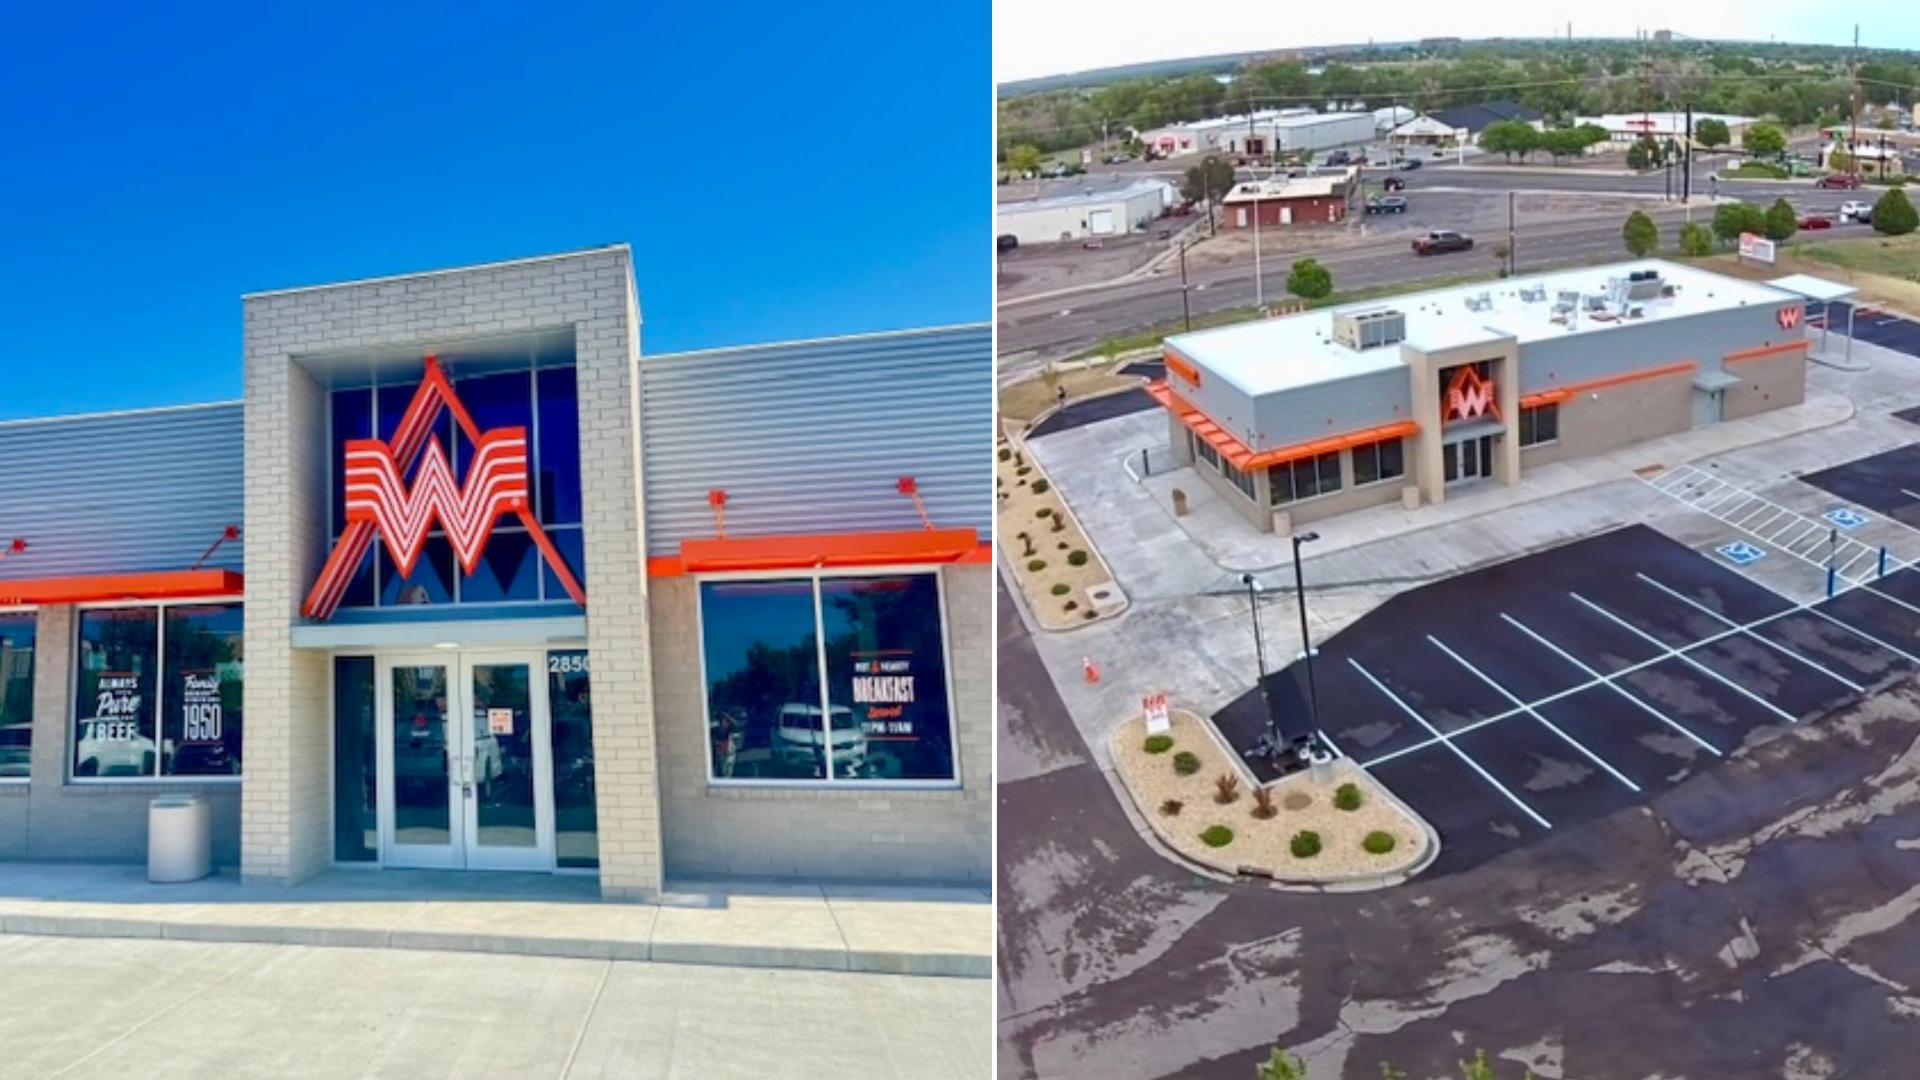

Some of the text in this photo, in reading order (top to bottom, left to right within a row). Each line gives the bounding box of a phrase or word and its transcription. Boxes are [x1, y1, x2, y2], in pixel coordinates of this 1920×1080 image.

[98, 678, 138, 689] ALWAYS
[852, 676, 914, 703] BREAKFAST
[96, 691, 142, 717] Pure
[96, 722, 136, 741] BEEF
[182, 703, 222, 740] 1950
